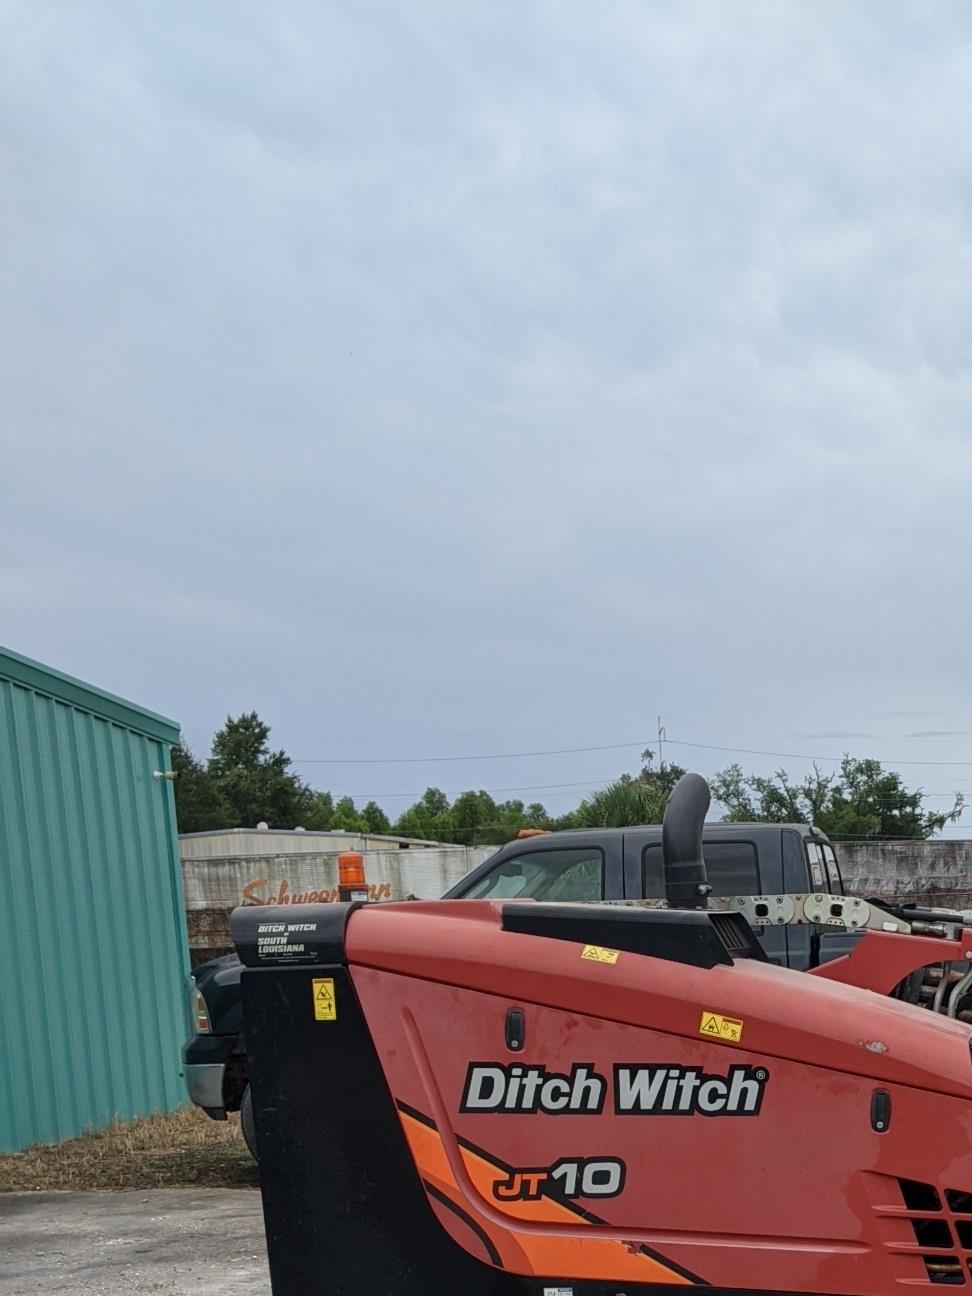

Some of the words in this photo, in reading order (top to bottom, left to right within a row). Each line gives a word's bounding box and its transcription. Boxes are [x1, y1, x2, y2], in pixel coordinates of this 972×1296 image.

[258, 925, 285, 933] DITCH
[287, 923, 316, 931] WITCH
[258, 937, 287, 946] SOUTH
[258, 944, 305, 954] LOUISIANA
[465, 1067, 602, 1109] Ditch
